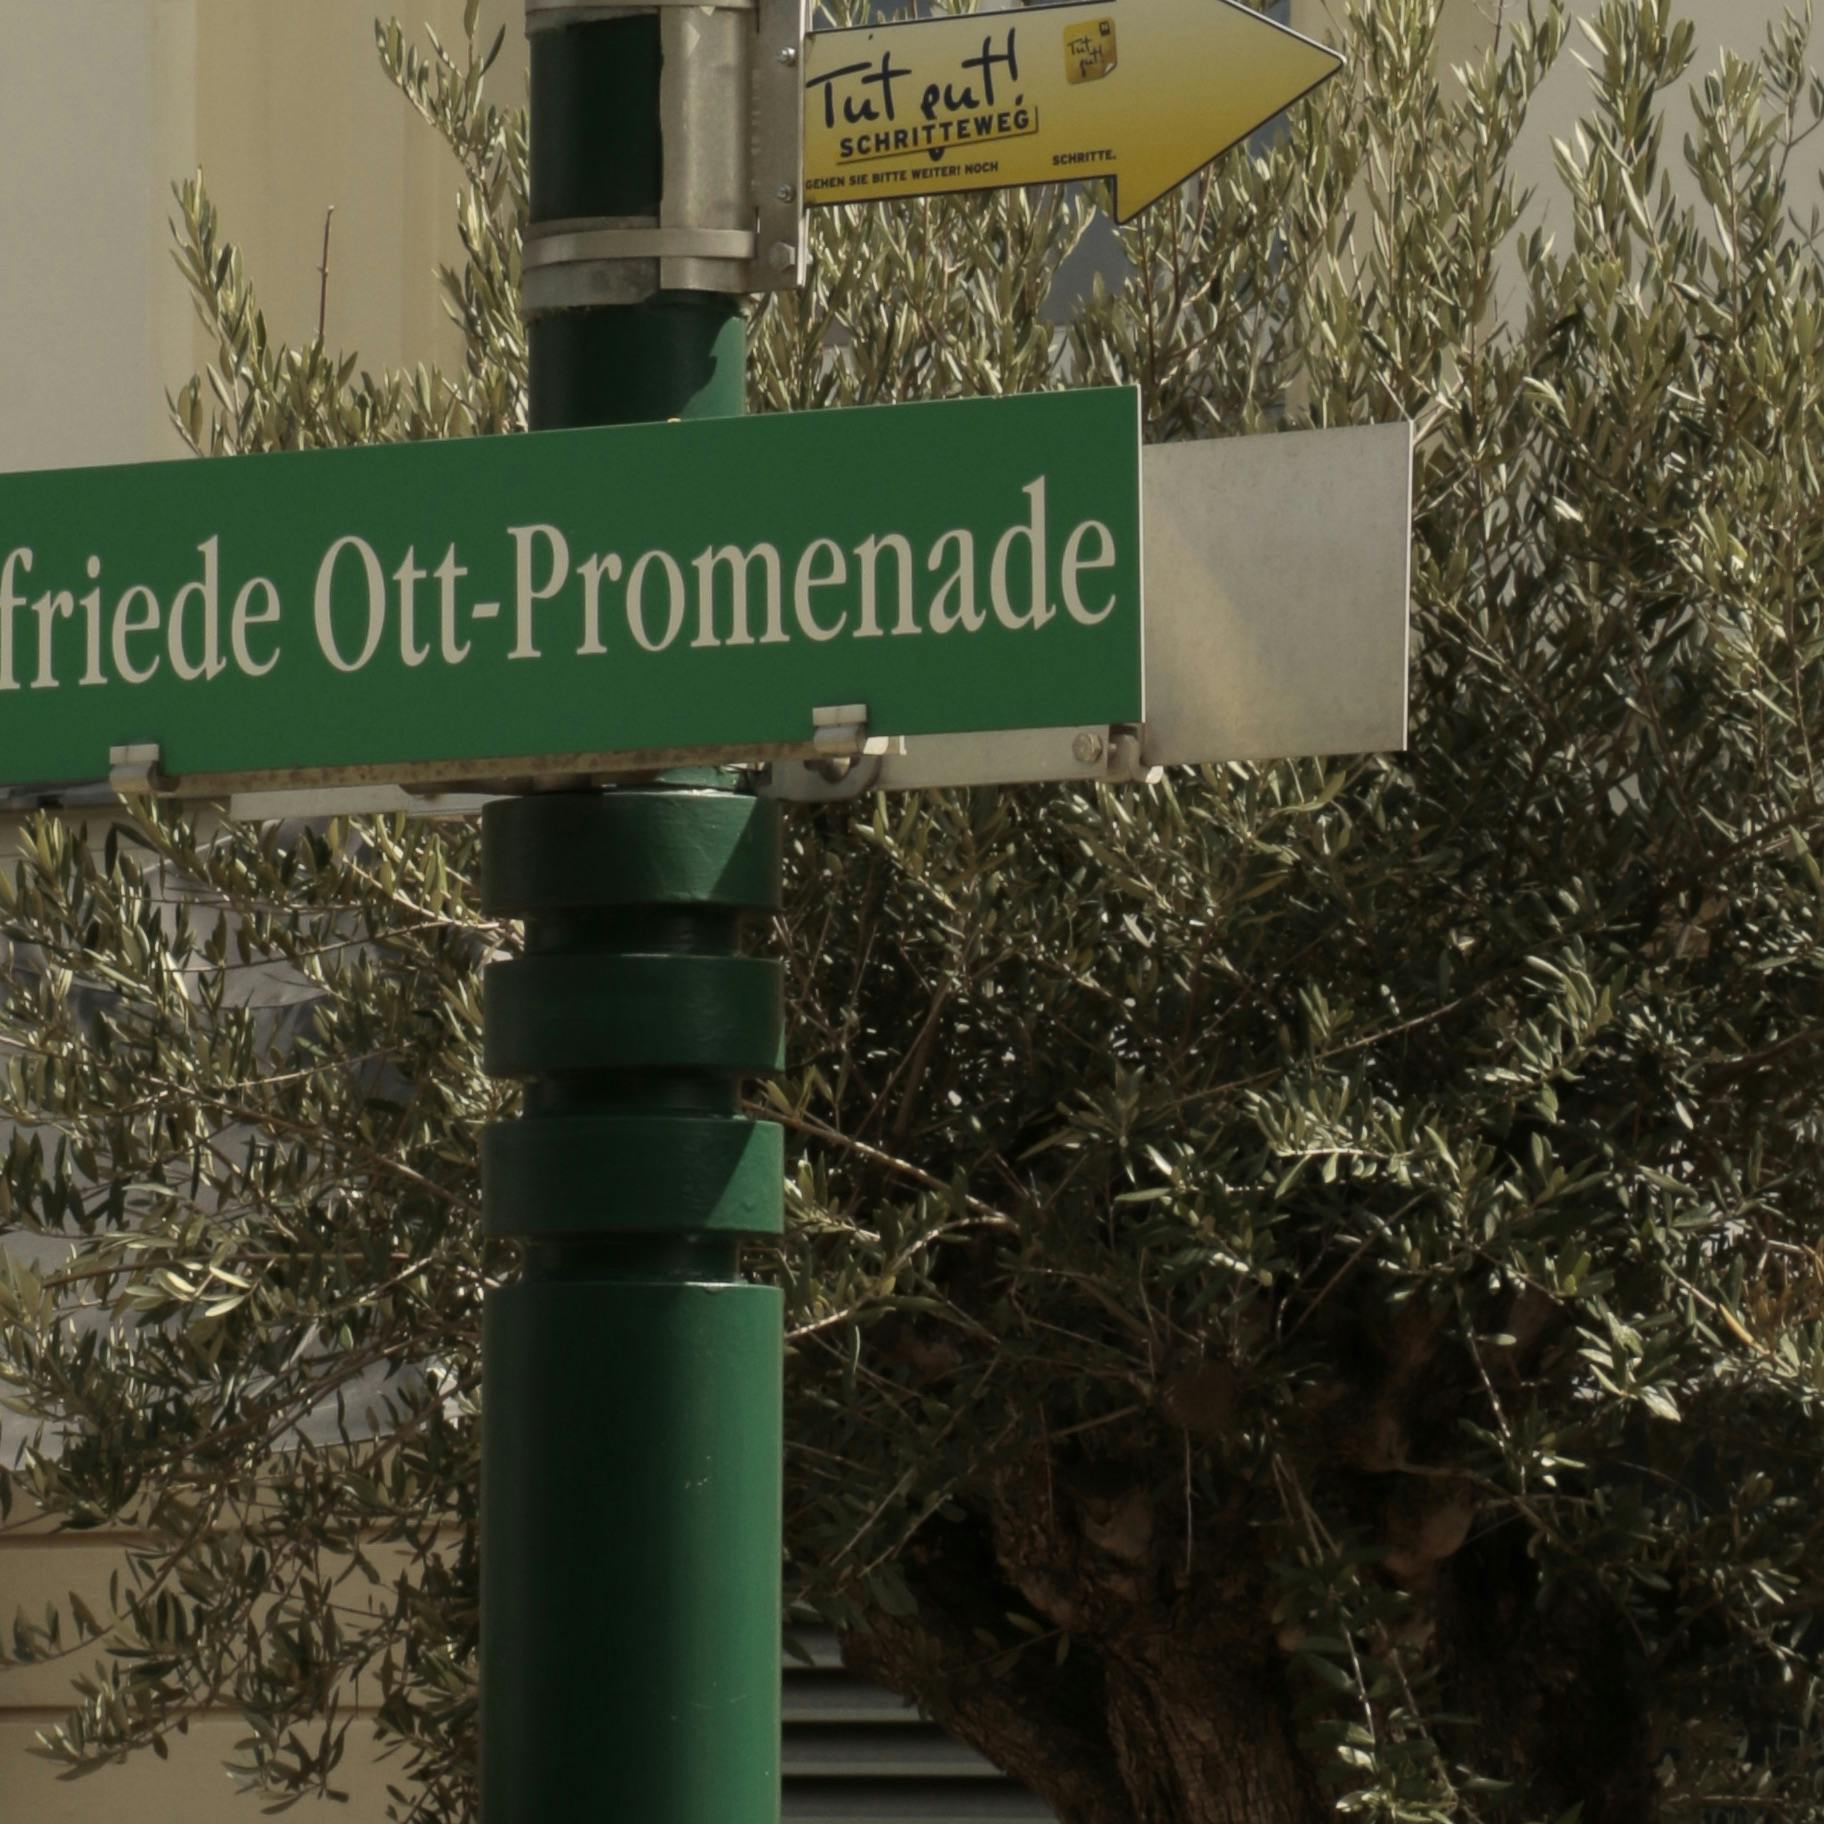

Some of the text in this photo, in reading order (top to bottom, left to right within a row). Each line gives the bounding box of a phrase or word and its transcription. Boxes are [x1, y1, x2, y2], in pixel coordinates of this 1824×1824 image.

[805, 50, 912, 128] Tut
[839, 109, 1030, 159] SCHRITTEWEG
[805, 148, 1117, 191] GEHEN SIE BITTE WEITER! NOCH SCHRITTE.
[313, 474, 1117, 672] Ott-Promenade
